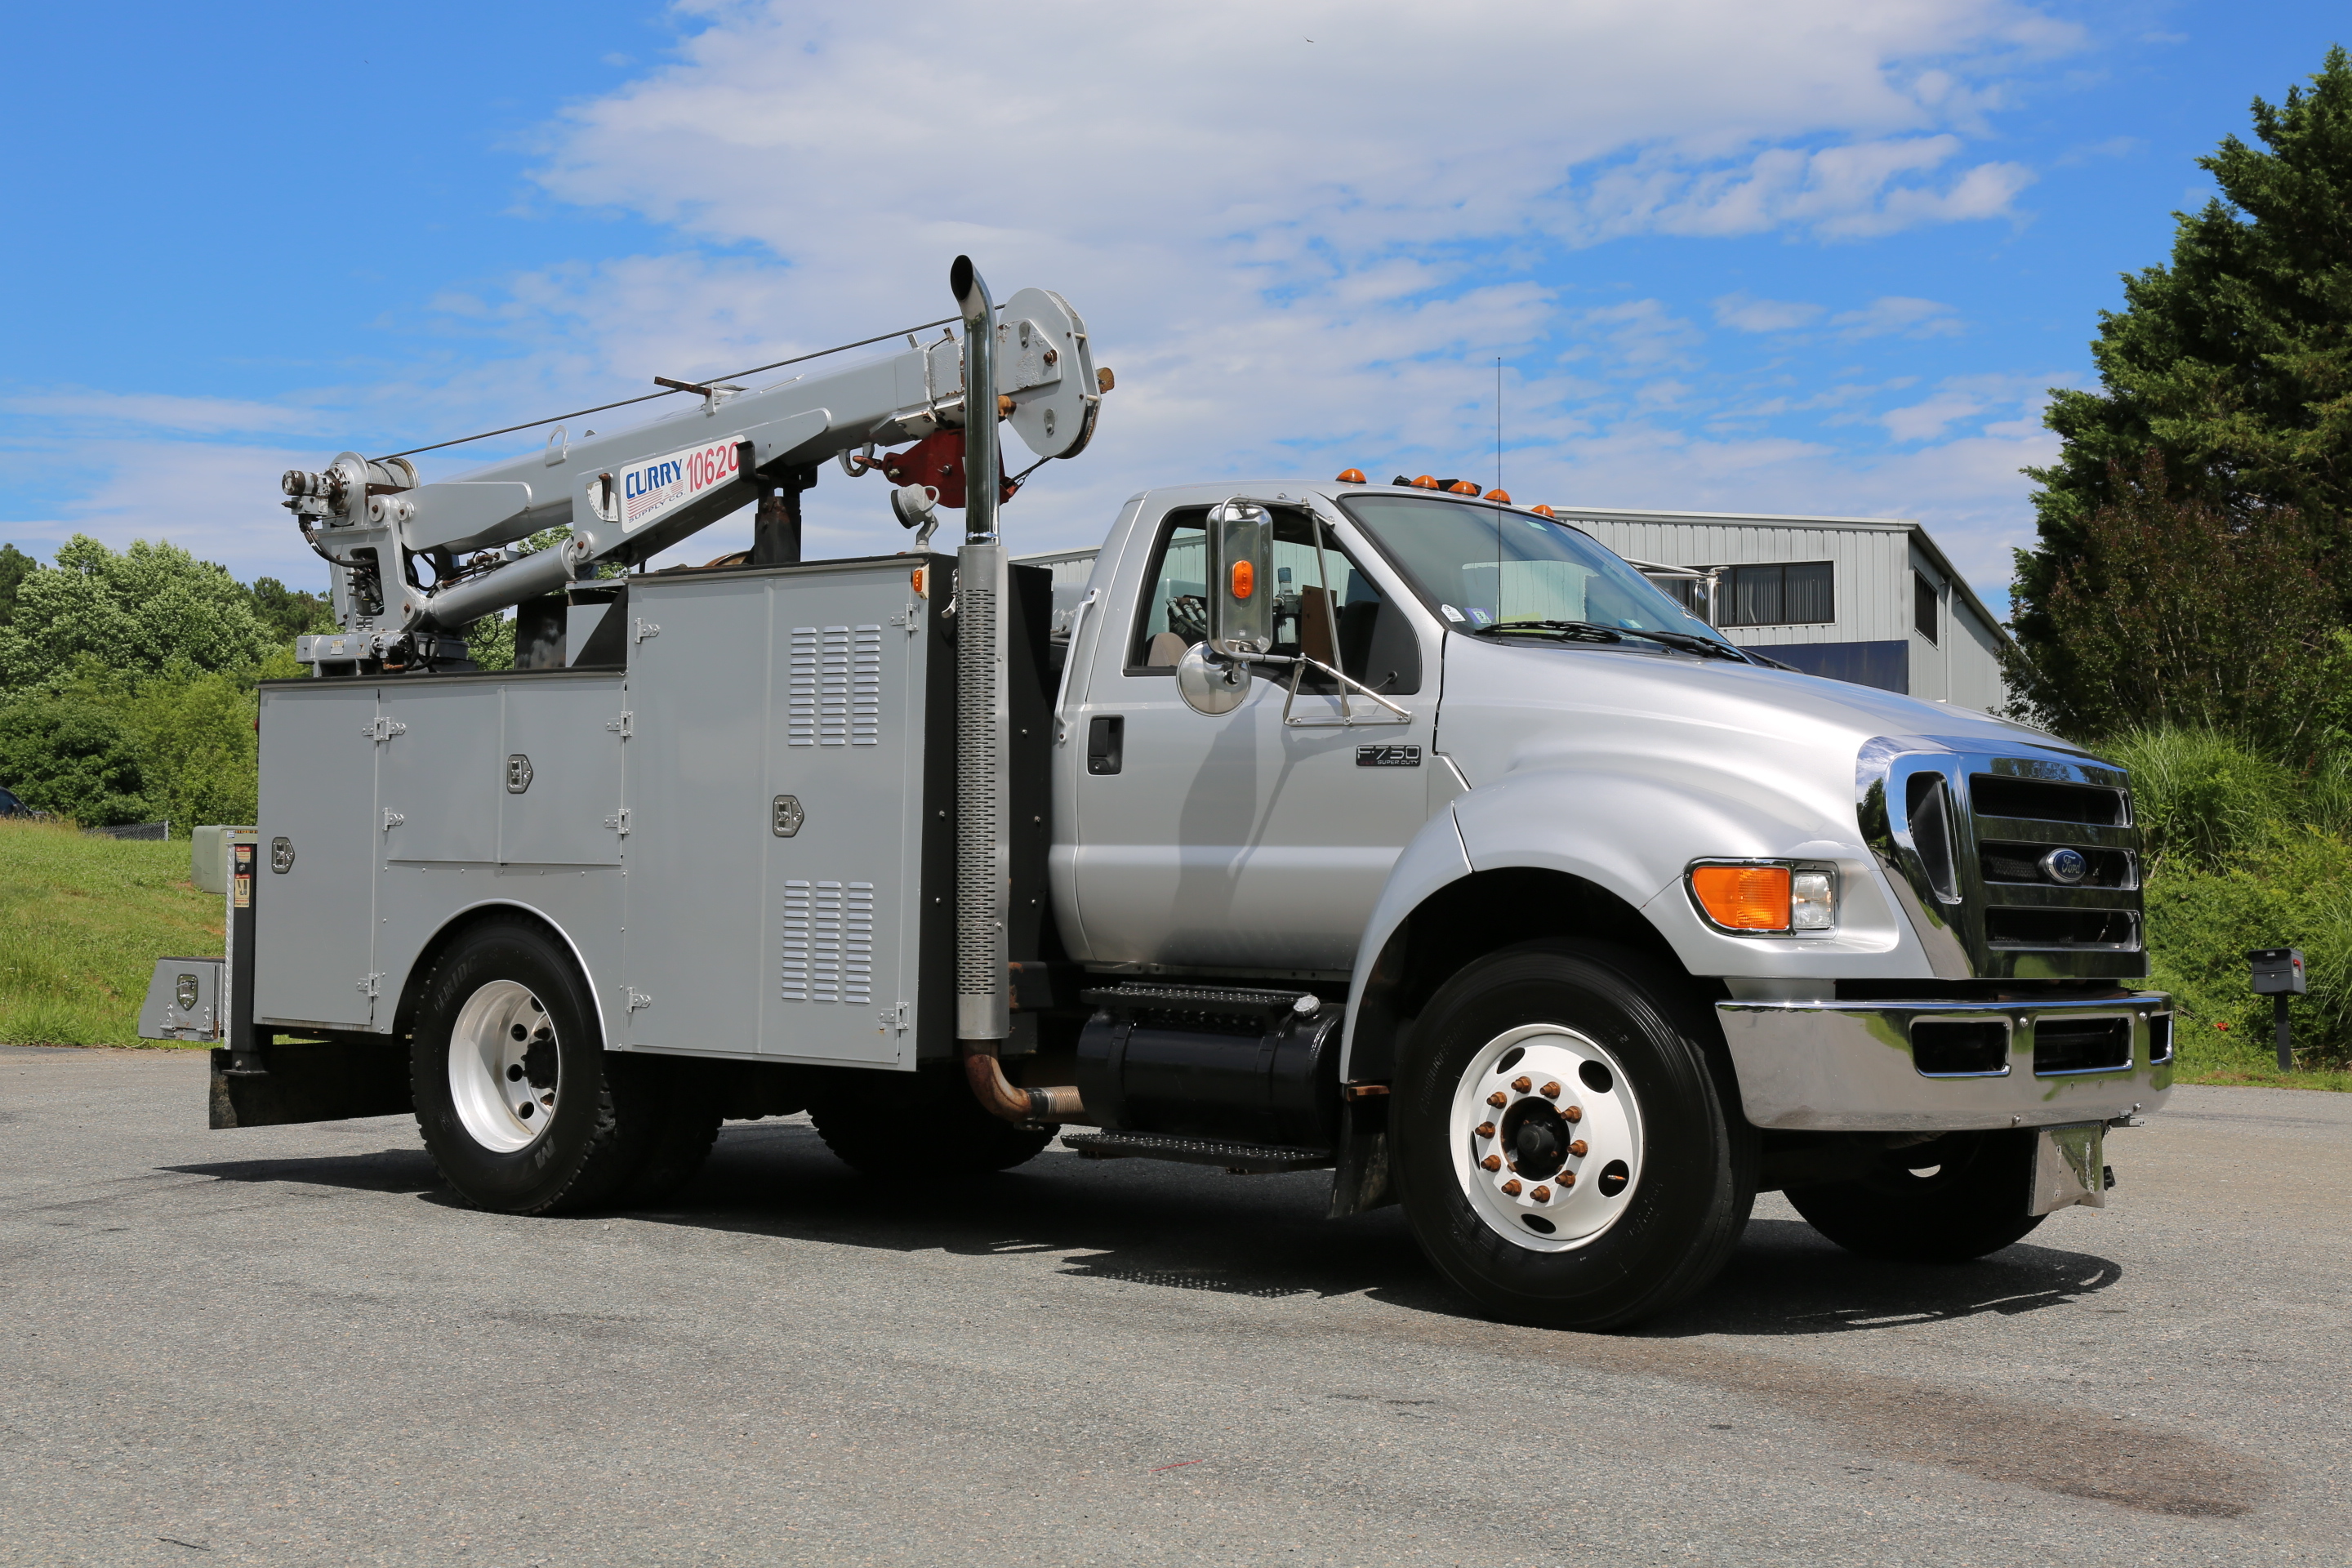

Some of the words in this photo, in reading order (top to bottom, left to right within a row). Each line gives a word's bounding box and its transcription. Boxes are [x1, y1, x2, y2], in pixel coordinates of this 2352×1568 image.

[626, 458, 683, 499] CURRY
[686, 441, 739, 492] 10620
[628, 500, 666, 523] SUPPLY
[669, 492, 686, 501] CO.
[2062, 854, 2081, 874] Ford
